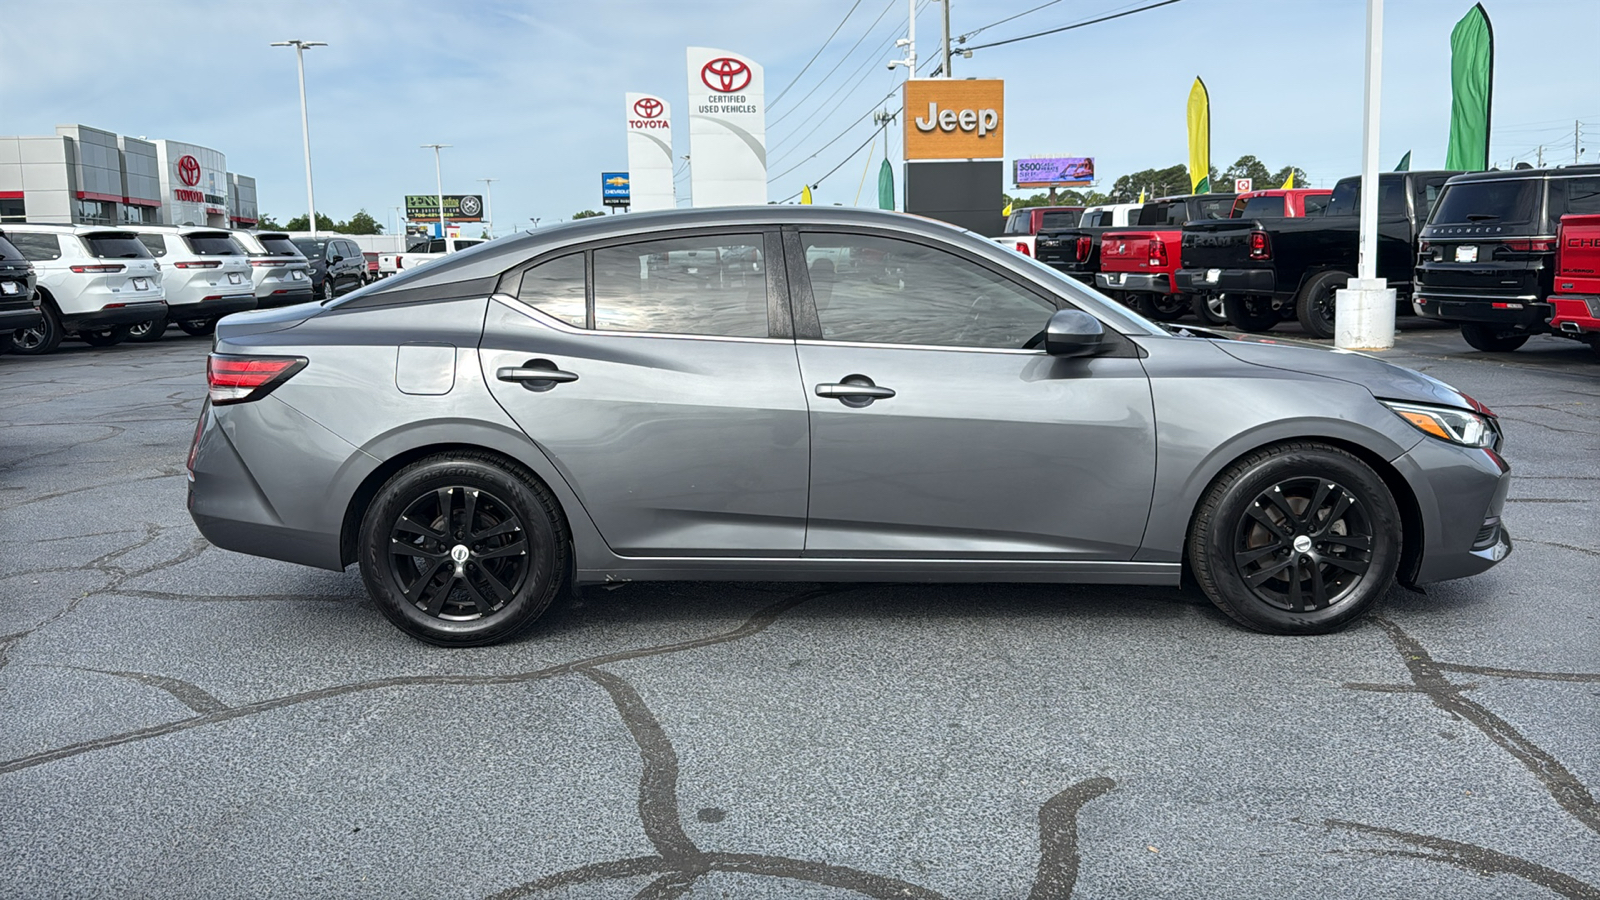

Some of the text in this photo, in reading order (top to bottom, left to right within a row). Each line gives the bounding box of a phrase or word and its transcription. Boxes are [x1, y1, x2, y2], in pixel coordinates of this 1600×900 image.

[708, 95, 746, 103] CERTIFIED
[699, 105, 757, 113] USED VEHICLES
[915, 102, 998, 135] Jeep
[629, 120, 669, 129] TOYOTA
[1019, 162, 1040, 171] $500
[175, 189, 205, 203] TOYOTA
[1194, 235, 1232, 247] RAM
